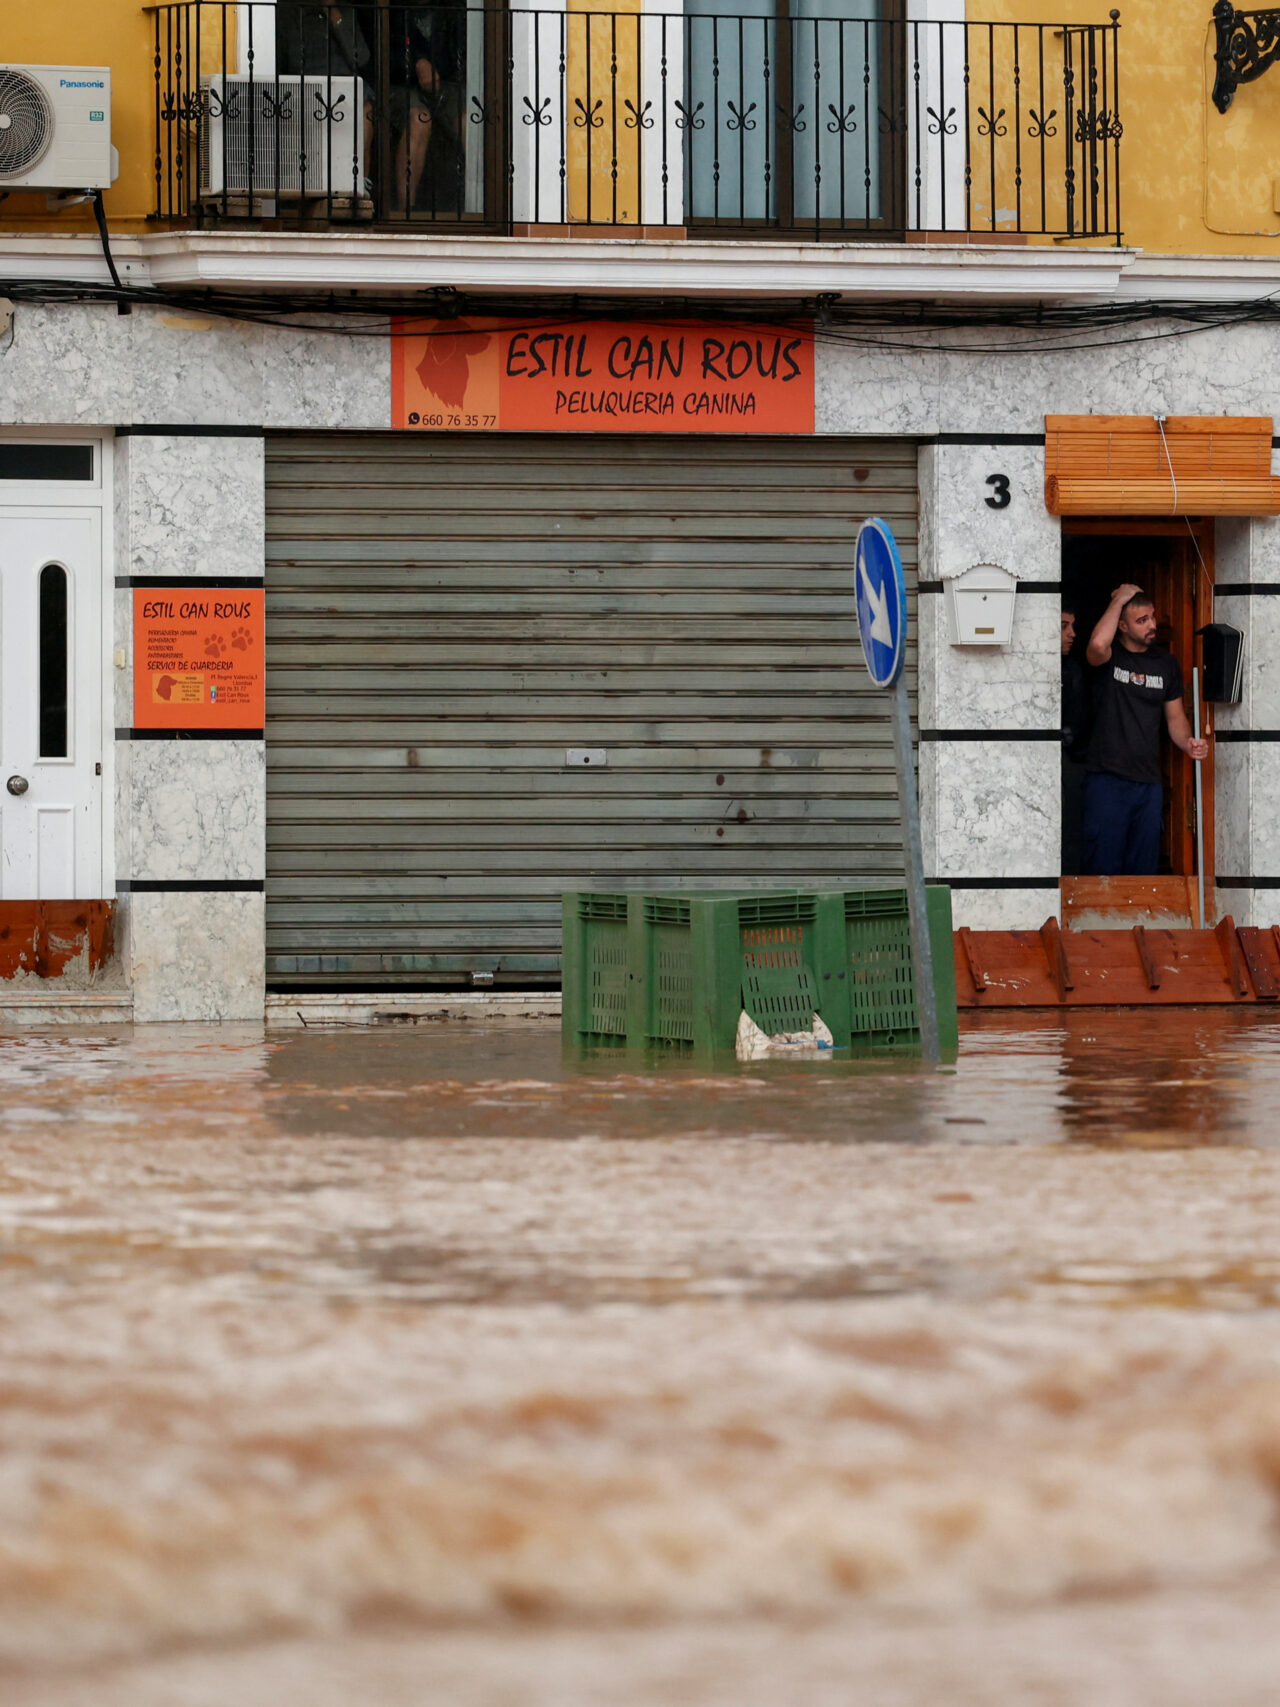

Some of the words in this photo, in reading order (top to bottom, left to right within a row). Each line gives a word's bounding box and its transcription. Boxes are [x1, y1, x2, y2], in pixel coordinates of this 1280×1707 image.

[59, 79, 104, 88] Panasonic
[506, 332, 592, 378] ESTIL
[608, 335, 685, 381] CAN
[701, 337, 802, 382] ROUS
[554, 390, 675, 417] PELUQUERIA
[683, 391, 756, 415] CANINA
[422, 414, 443, 427] 660
[447, 414, 461, 427] 76
[465, 414, 478, 427] 35
[483, 415, 496, 427] 77
[984, 473, 1011, 510] 3
[143, 602, 175, 619] ESTIL
[179, 602, 209, 619] CAN
[213, 602, 251, 619] ROUS
[147, 661, 176, 671] SERVICI
[178, 661, 189, 671] DE
[190, 661, 234, 671] GUARDERIA
